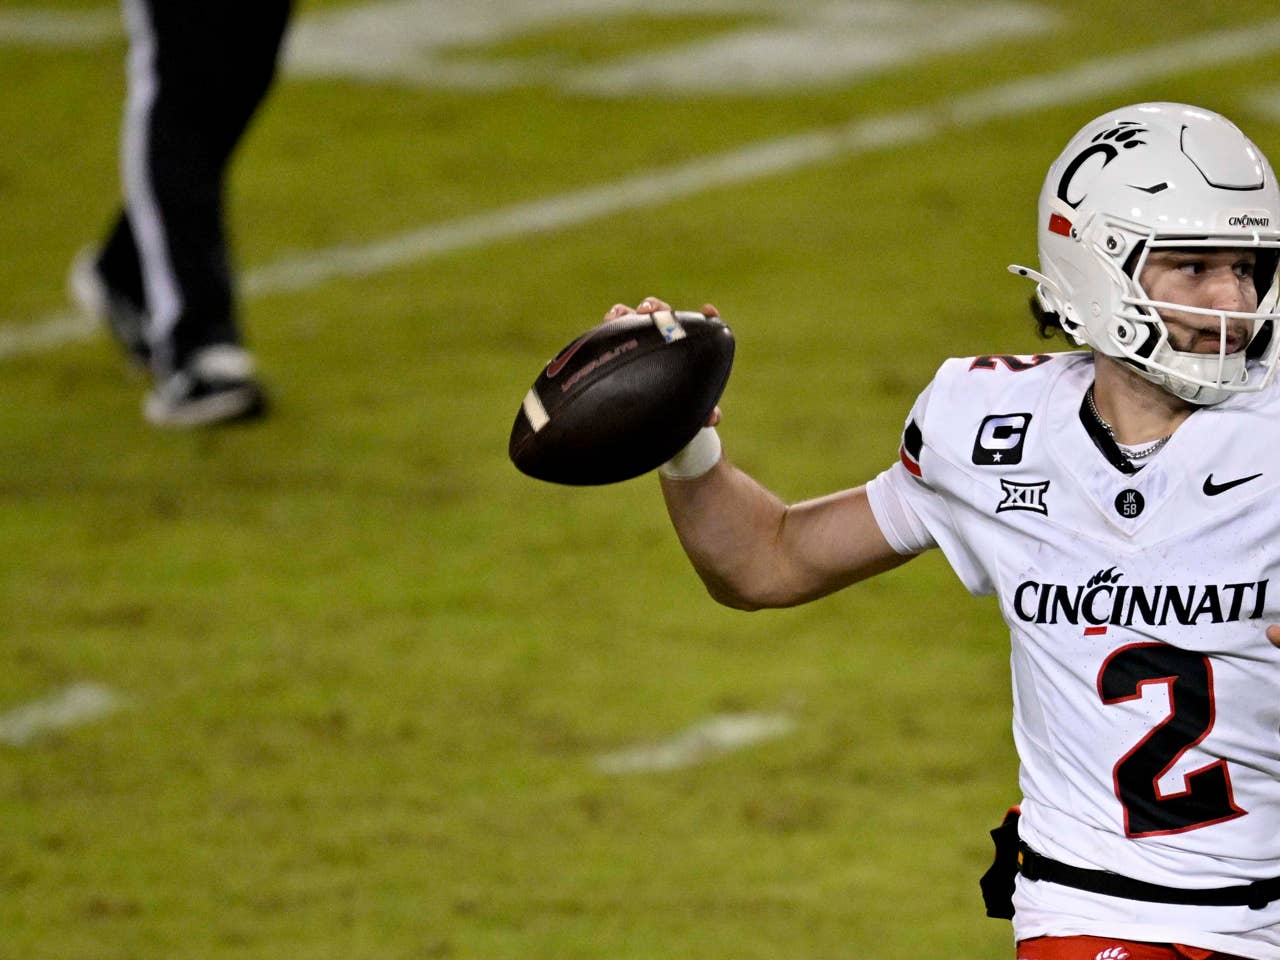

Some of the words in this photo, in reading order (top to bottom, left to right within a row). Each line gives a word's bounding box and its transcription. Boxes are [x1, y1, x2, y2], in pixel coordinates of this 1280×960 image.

[1228, 214, 1270, 228] CINCINNATI
[979, 415, 1026, 450] C
[1000, 481, 1047, 512] XII
[1122, 491, 1137, 504] JK
[1123, 503, 1137, 516] 58
[1013, 578, 1270, 627] CINCINNATI
[1096, 641, 1249, 839] 2
